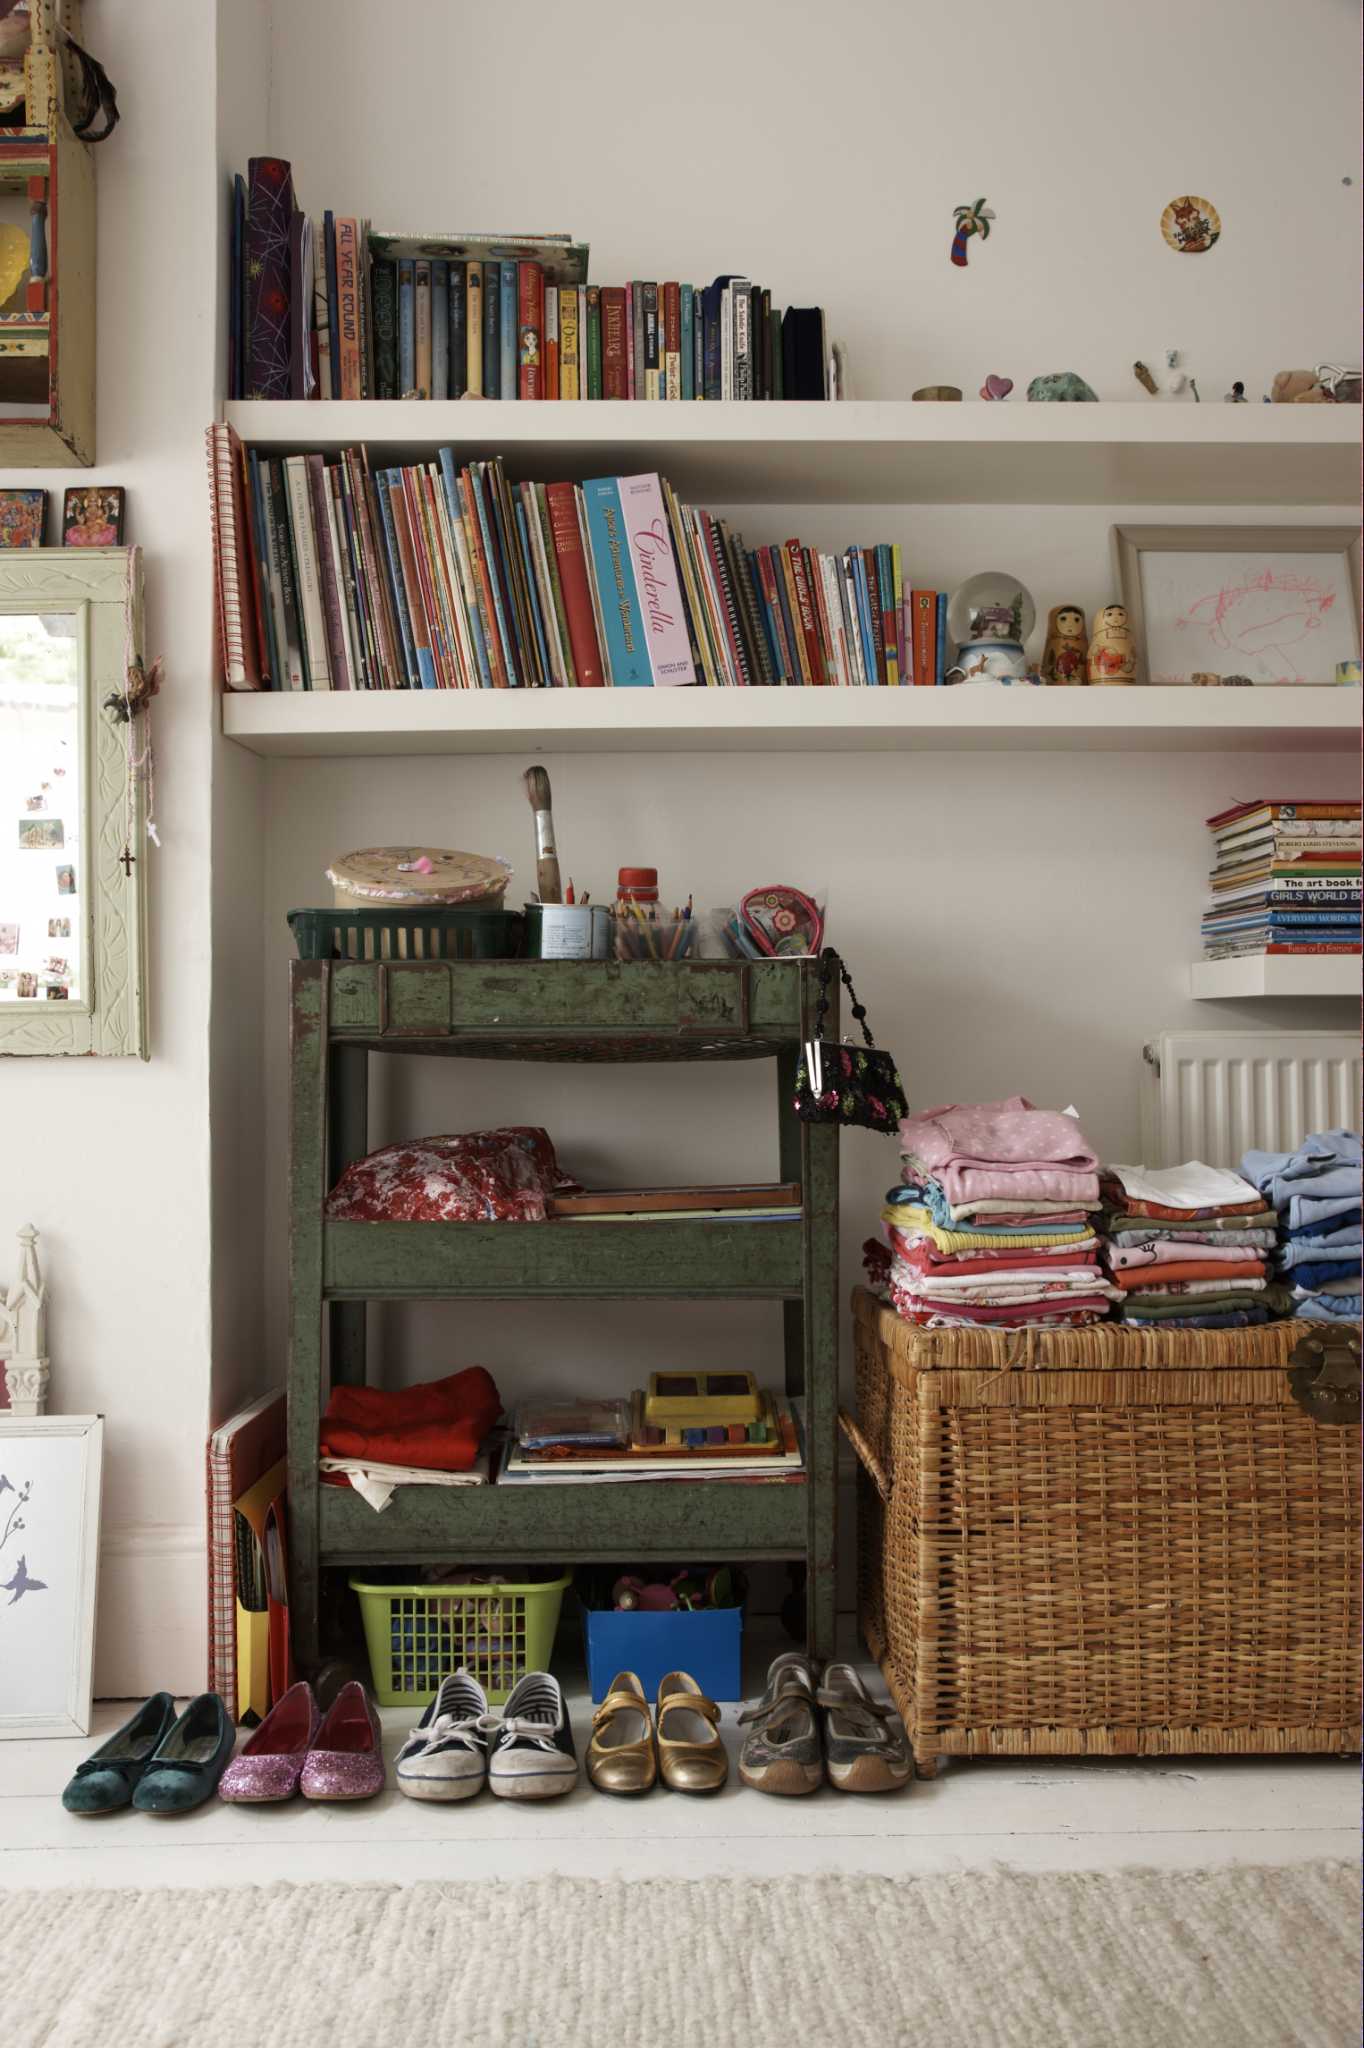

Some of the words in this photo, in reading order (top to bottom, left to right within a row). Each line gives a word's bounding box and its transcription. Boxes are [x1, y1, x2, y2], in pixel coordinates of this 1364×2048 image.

[341, 224, 353, 244] ALL
[341, 251, 354, 288] YEAR
[738, 299, 746, 309] The
[343, 294, 356, 341] ROUND
[738, 310, 746, 330] Subtle
[738, 332, 746, 350] Knife
[669, 354, 677, 378] Twist
[633, 518, 674, 634] Cinderella
[791, 556, 803, 576] THE
[799, 605, 812, 631] BOOK
[1284, 879, 1303, 887] The
[1306, 879, 1322, 887] art
[1326, 879, 1353, 887] book
[1307, 890, 1348, 901] WORLD
